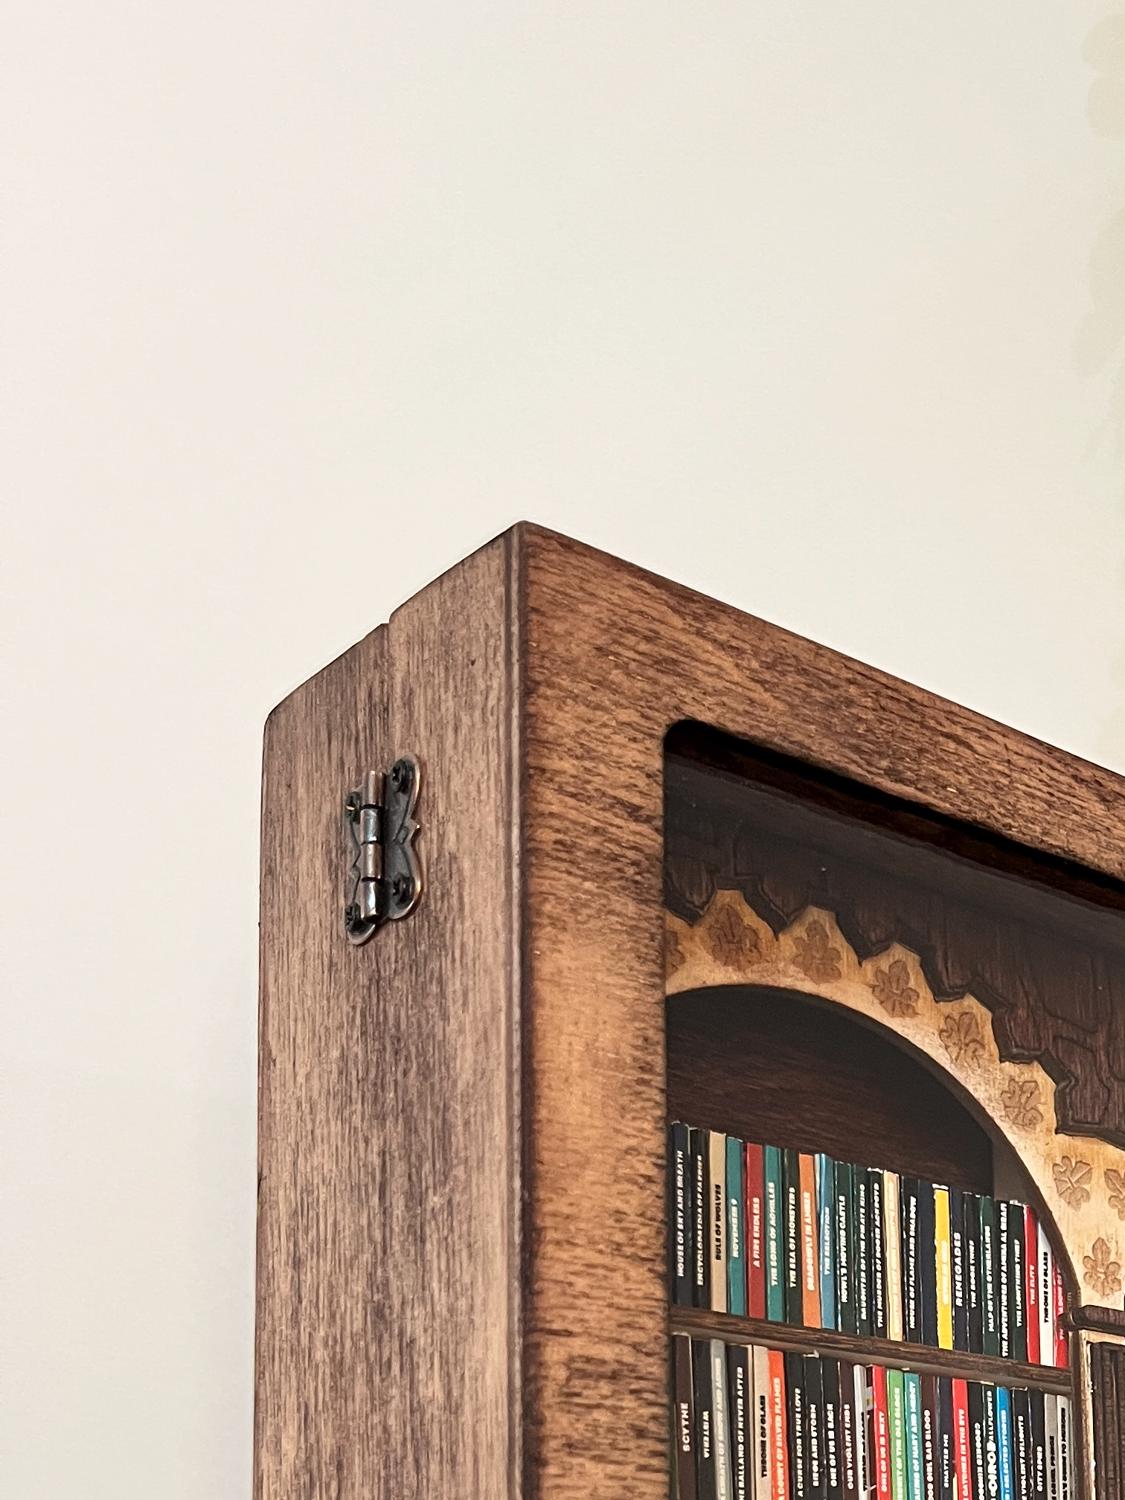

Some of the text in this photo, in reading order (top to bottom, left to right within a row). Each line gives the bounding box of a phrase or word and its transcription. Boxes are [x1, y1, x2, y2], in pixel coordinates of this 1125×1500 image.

[677, 1231, 684, 1244] OF
[715, 1224, 721, 1236] OF
[789, 1239, 796, 1250] OF
[839, 1230, 847, 1266] MOVING
[985, 1226, 993, 1282] OTHERLANDS
[754, 1260, 760, 1268] A
[860, 1258, 866, 1270] OF
[954, 1232, 963, 1307] RENEGADES
[840, 1268, 848, 1303] HOWL'S
[909, 1286, 916, 1298] OF
[1044, 1279, 1049, 1289] OF
[987, 1300, 994, 1312] OF
[774, 1377, 782, 1414] FLAMES
[681, 1402, 691, 1452] SCYTHE
[760, 1425, 767, 1439] OF
[775, 1415, 783, 1446] SILVER
[924, 1409, 932, 1440] BLOOD
[738, 1430, 744, 1443] OF
[827, 1403, 838, 1487] ONE OF US IS BACK
[943, 1434, 949, 1447] ME
[1018, 1416, 1026, 1457] DELIGHTS
[776, 1447, 784, 1460] OF
[845, 1429, 853, 1468] VIOLENT
[960, 1444, 967, 1454] IN
[777, 1461, 785, 1493] COURT
[961, 1455, 969, 1496] CATCHER
